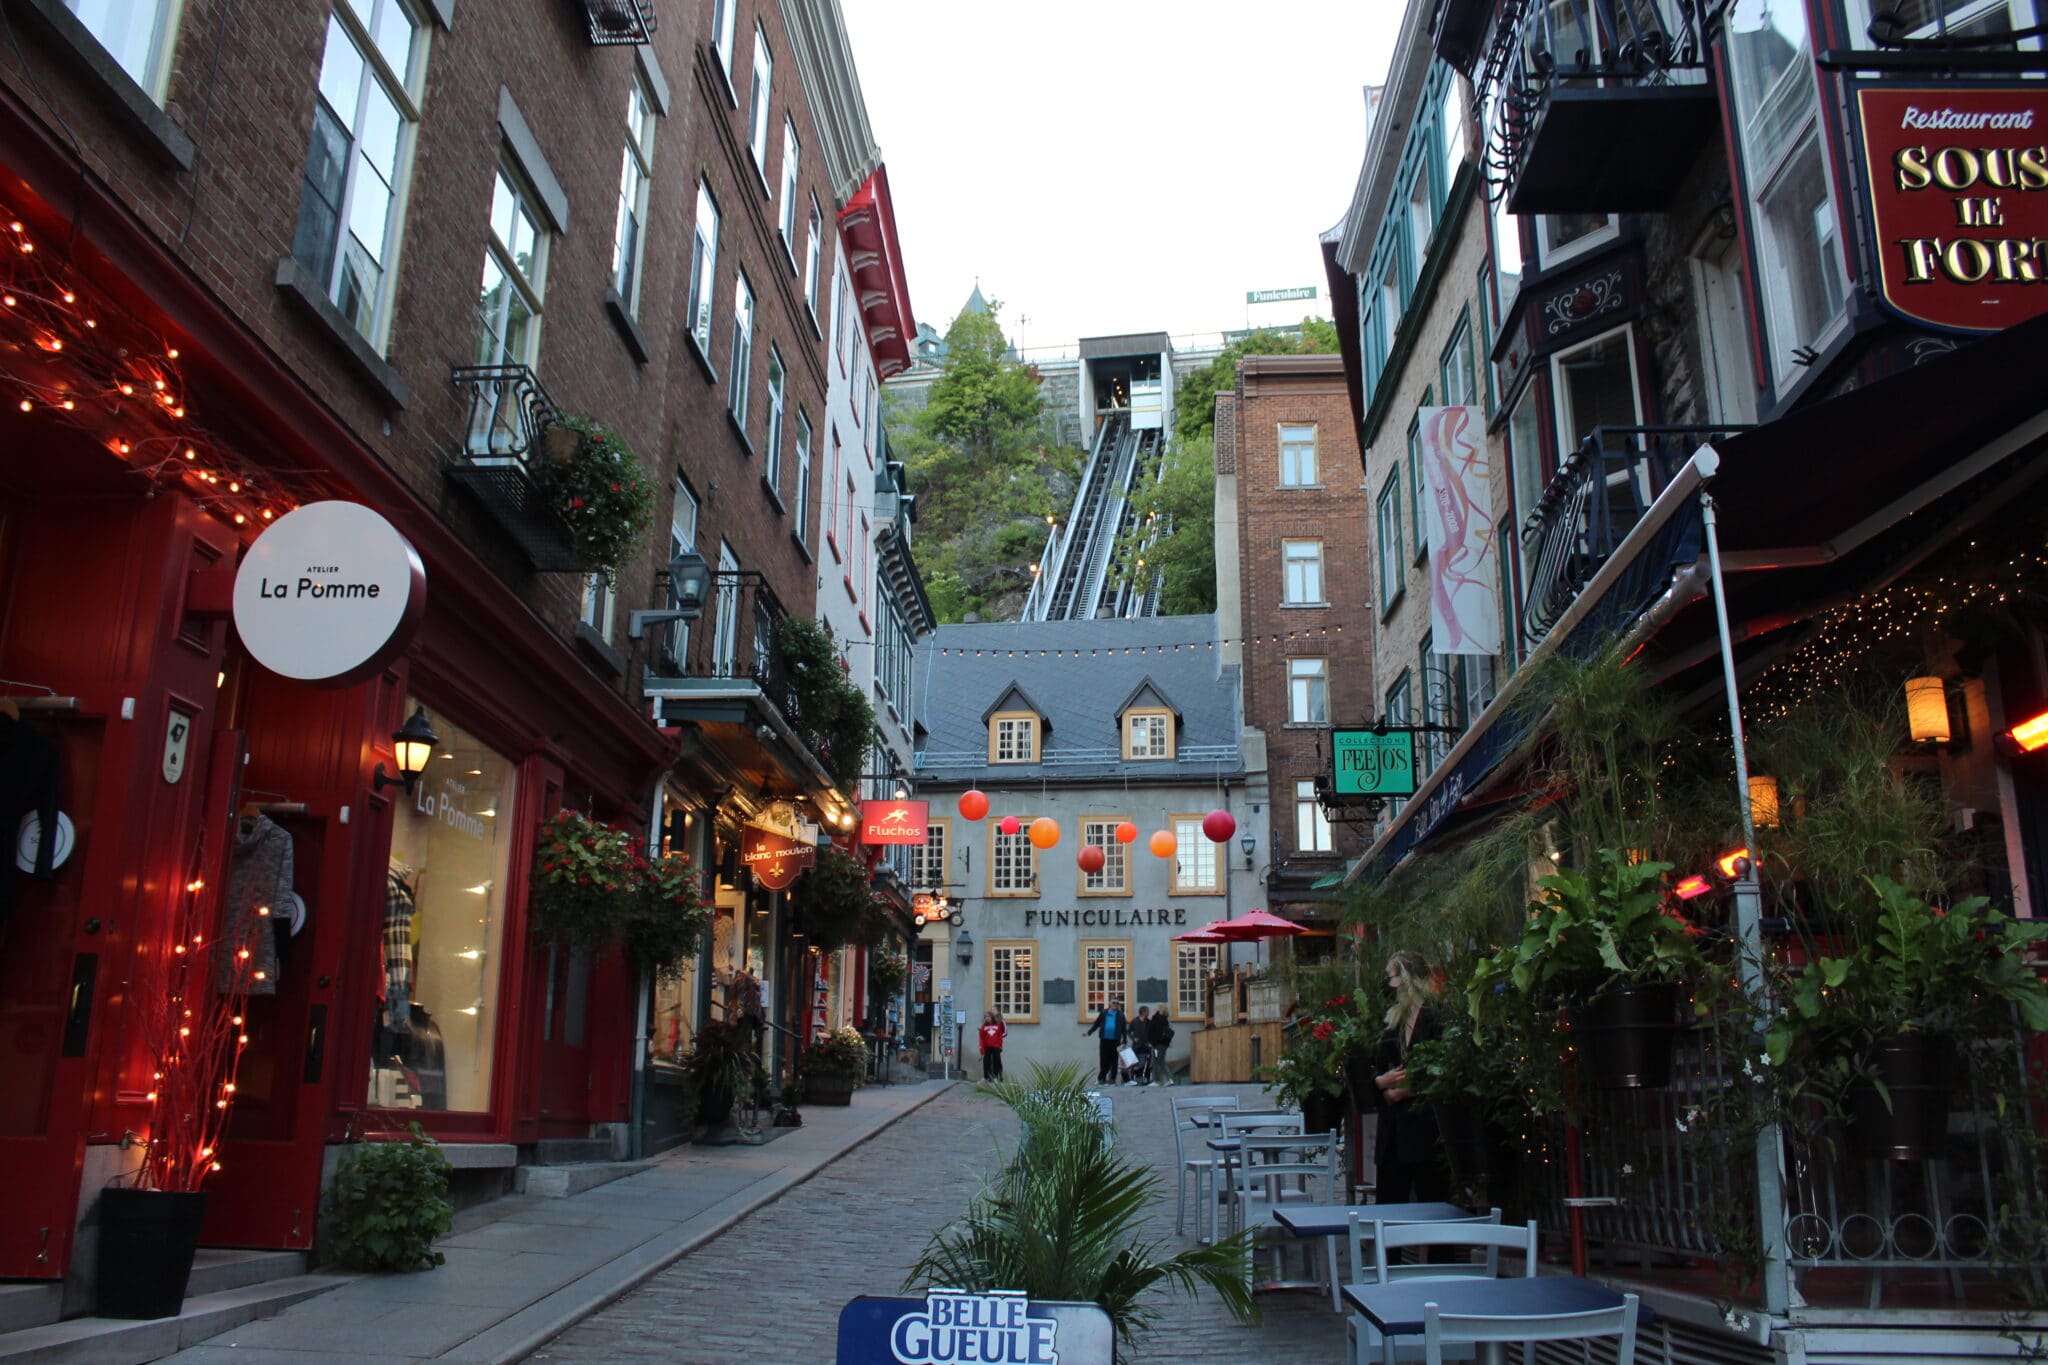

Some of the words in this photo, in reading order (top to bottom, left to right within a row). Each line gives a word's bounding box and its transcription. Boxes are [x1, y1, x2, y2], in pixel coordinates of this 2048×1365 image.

[1901, 106, 2034, 129] Restaurant
[1895, 145, 2048, 191] SOUS
[1957, 197, 2003, 226] LE
[1254, 288, 1310, 302] Funiculaire
[260, 577, 288, 598] La
[297, 577, 380, 598] Pomme
[417, 781, 435, 816] La
[439, 792, 485, 841] Pomme
[868, 825, 921, 836] Fluchos
[744, 851, 771, 862] blanc
[775, 846, 813, 857] mouton
[756, 843, 766, 852] le
[1025, 909, 1187, 927] FUNICULAIRE
[931, 1298, 1024, 1329] BELLE
[895, 1315, 1054, 1364] GUEULE
